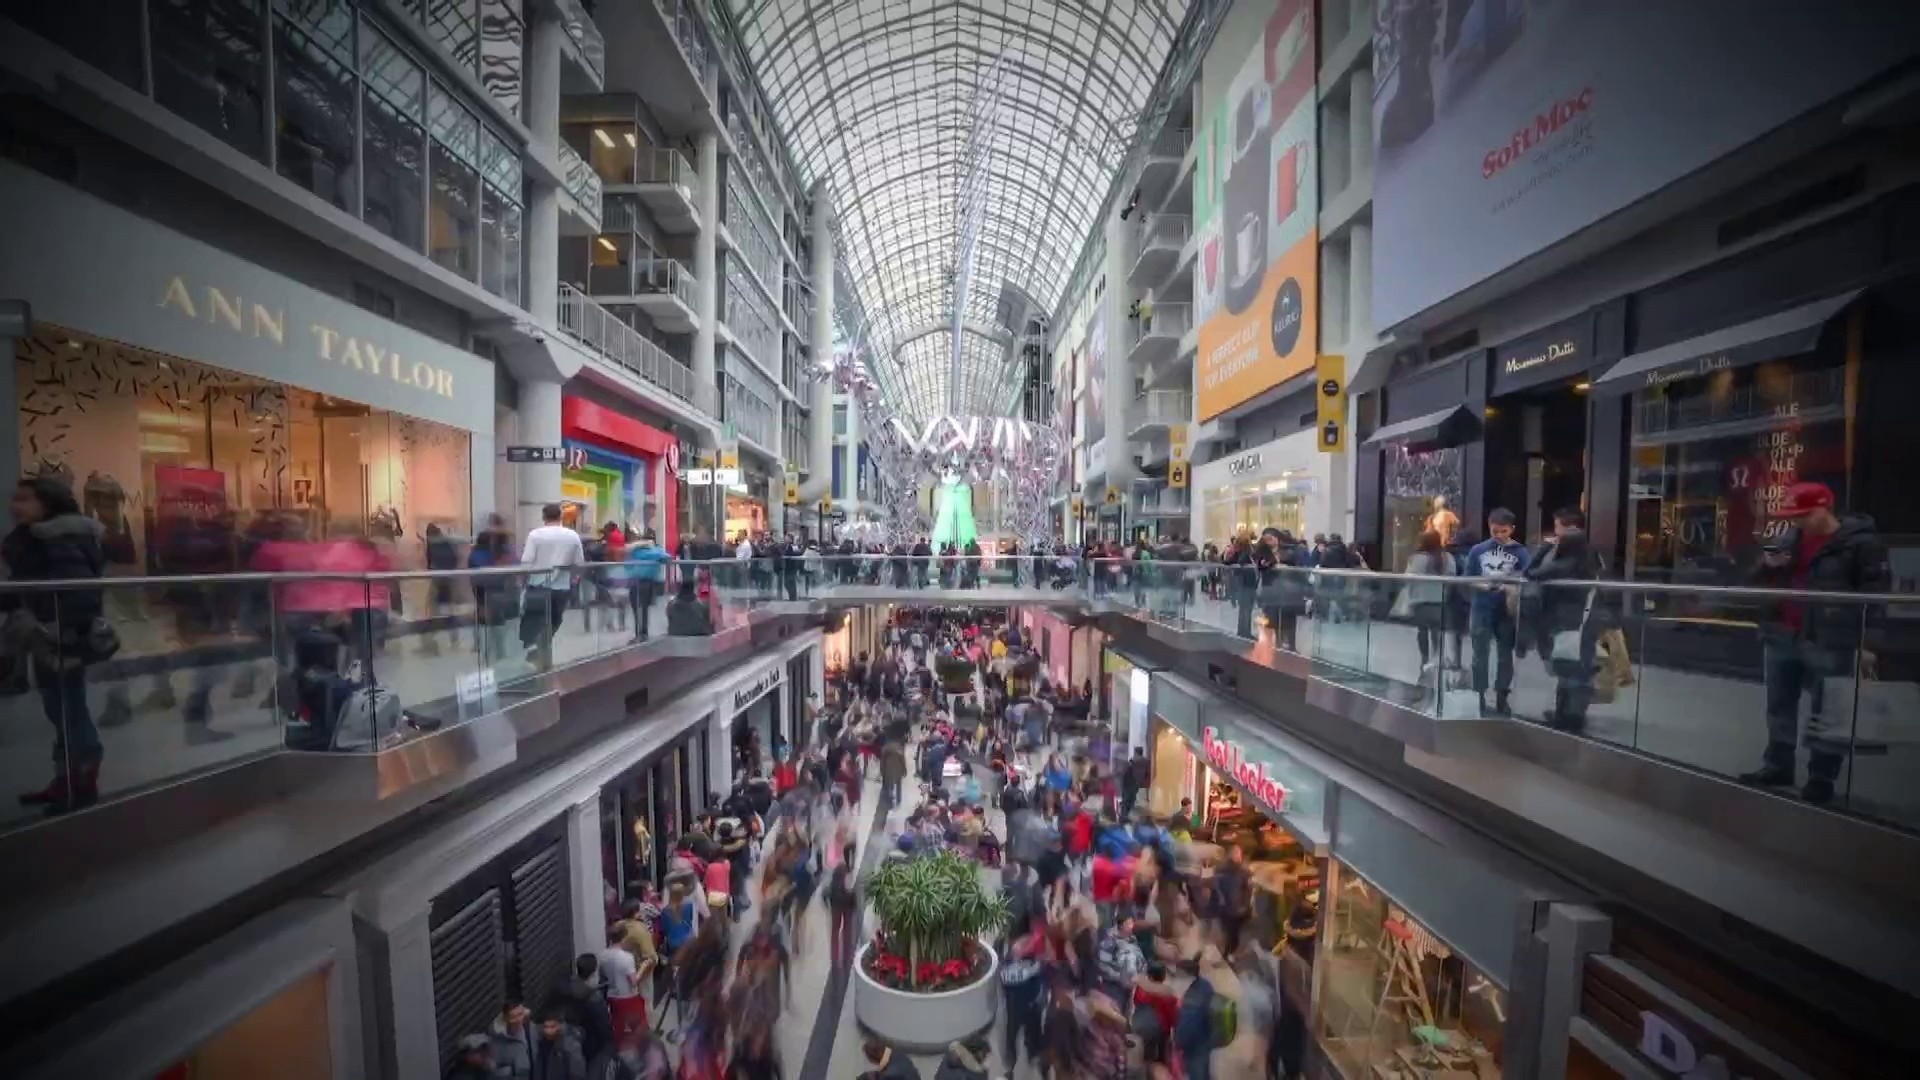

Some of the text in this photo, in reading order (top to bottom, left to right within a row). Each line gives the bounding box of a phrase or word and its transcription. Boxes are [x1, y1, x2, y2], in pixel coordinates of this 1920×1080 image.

[1482, 86, 1595, 180] SoftMoc
[157, 276, 455, 399] ANN TAYLOR
[1548, 341, 1575, 360] Dutti
[1203, 726, 1286, 813] Foot Locker
